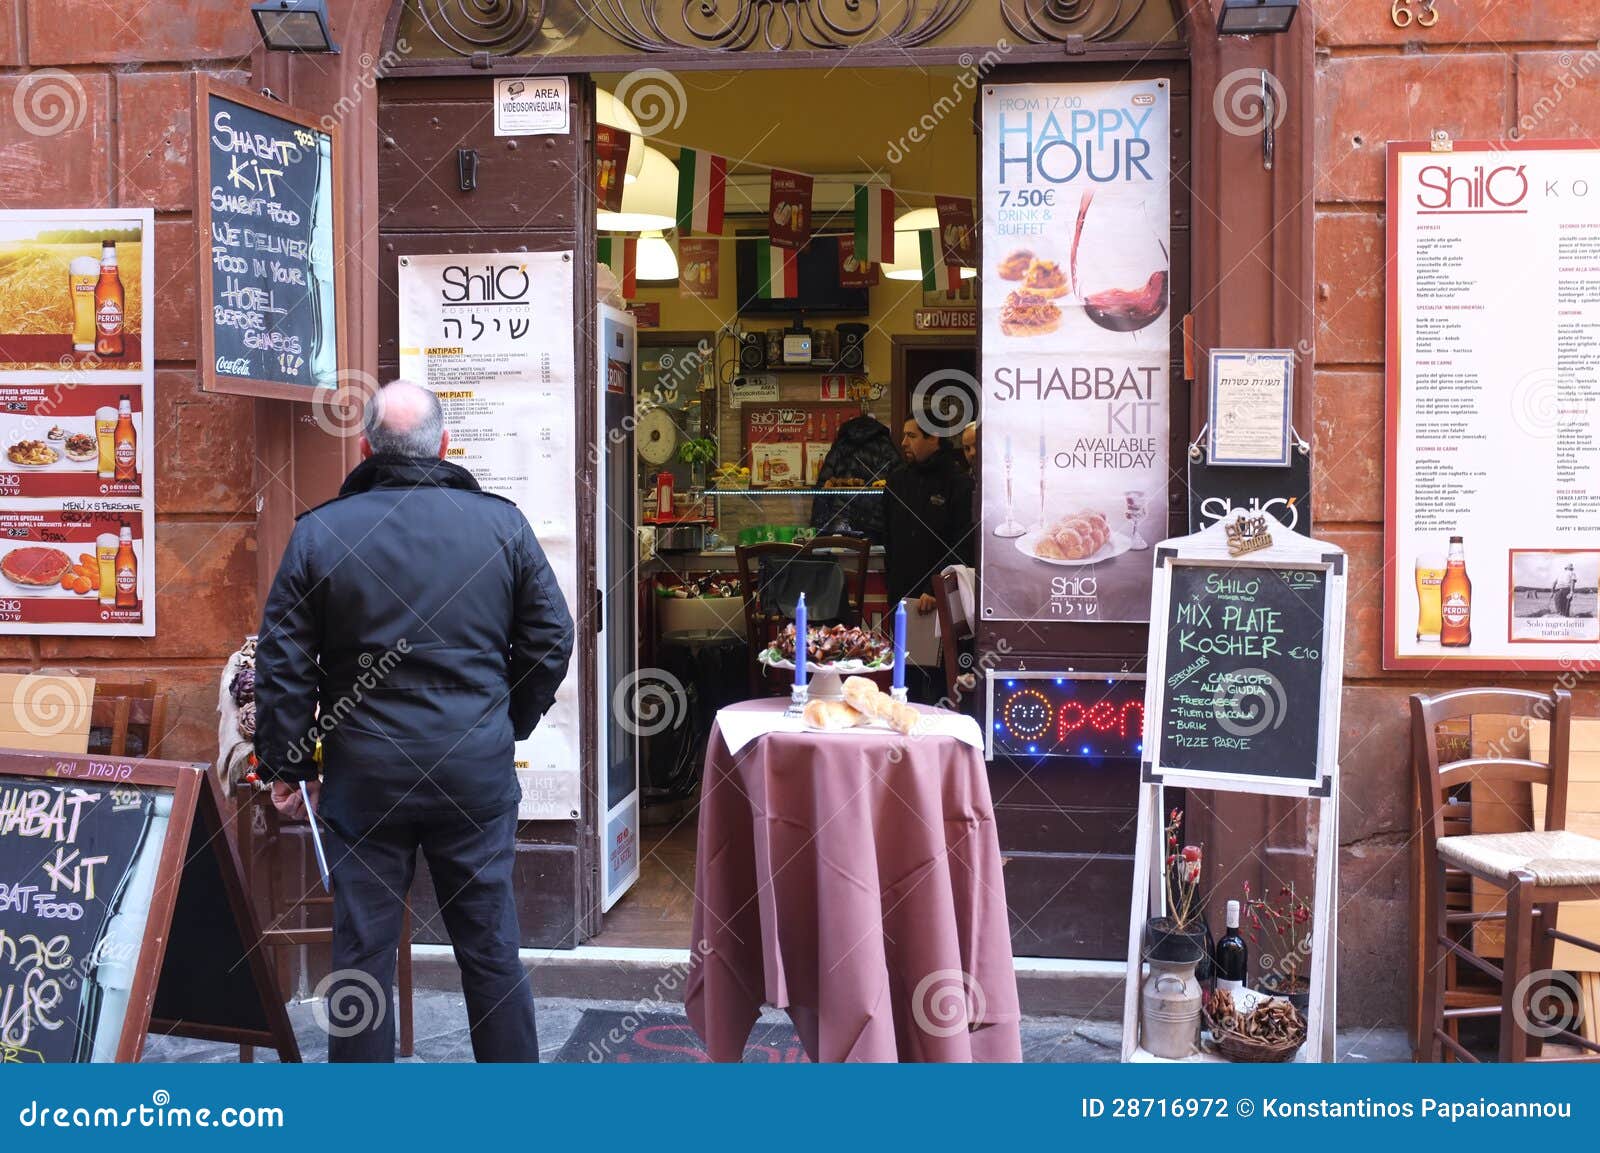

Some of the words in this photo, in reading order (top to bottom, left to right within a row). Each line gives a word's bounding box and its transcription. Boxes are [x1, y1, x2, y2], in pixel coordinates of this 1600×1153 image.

[534, 88, 560, 98] AREA
[502, 102, 562, 112] VIDEOSORVEGLIATA
[999, 98, 1040, 111] FROM
[999, 108, 1153, 153] HAPPY
[999, 138, 1154, 184] HOUR
[998, 189, 1056, 208] 7.50€
[267, 202, 300, 226] FOOD
[998, 210, 1039, 222] DRINK
[1043, 209, 1052, 221] &
[998, 222, 1046, 235] BUFFET
[212, 222, 241, 246] WE
[244, 229, 309, 260] DELIVER
[212, 246, 248, 274] FOOD
[253, 258, 267, 279] IN
[270, 262, 306, 286] YOUR
[221, 275, 287, 315] HOTEL
[214, 304, 265, 331] BEFORE
[442, 306, 492, 314] KOSHER
[97, 314, 122, 322] PERONI
[916, 312, 976, 327] BUDWEISE
[443, 314, 530, 342] שילה
[994, 366, 1161, 400] SHABBAT
[1108, 402, 1160, 434] KIT
[1074, 438, 1156, 452] AVAILABLE
[1054, 452, 1086, 469] ON
[1093, 452, 1157, 469] FRIDAY
[102, 503, 142, 511] PERSONE
[1051, 602, 1097, 616] שילה
[1176, 602, 1213, 628] MIX
[1222, 606, 1284, 633] PLATE
[1545, 620, 1585, 629] ingredienti
[1179, 629, 1282, 659] KOSHER
[1288, 646, 1319, 660] €10
[1208, 673, 1272, 685] CARCIOFO
[1200, 684, 1225, 692] ALLA
[1228, 685, 1266, 696] GIUDIA
[1205, 710, 1214, 718] DI
[1176, 720, 1207, 731] BURIK
[1176, 735, 1209, 748] PIZZE
[1212, 736, 1252, 750] PARVE
[0, 787, 101, 844] HABAT
[520, 802, 557, 814] RIDAY
[0, 882, 38, 914] BAT
[33, 894, 84, 921] FOOD
